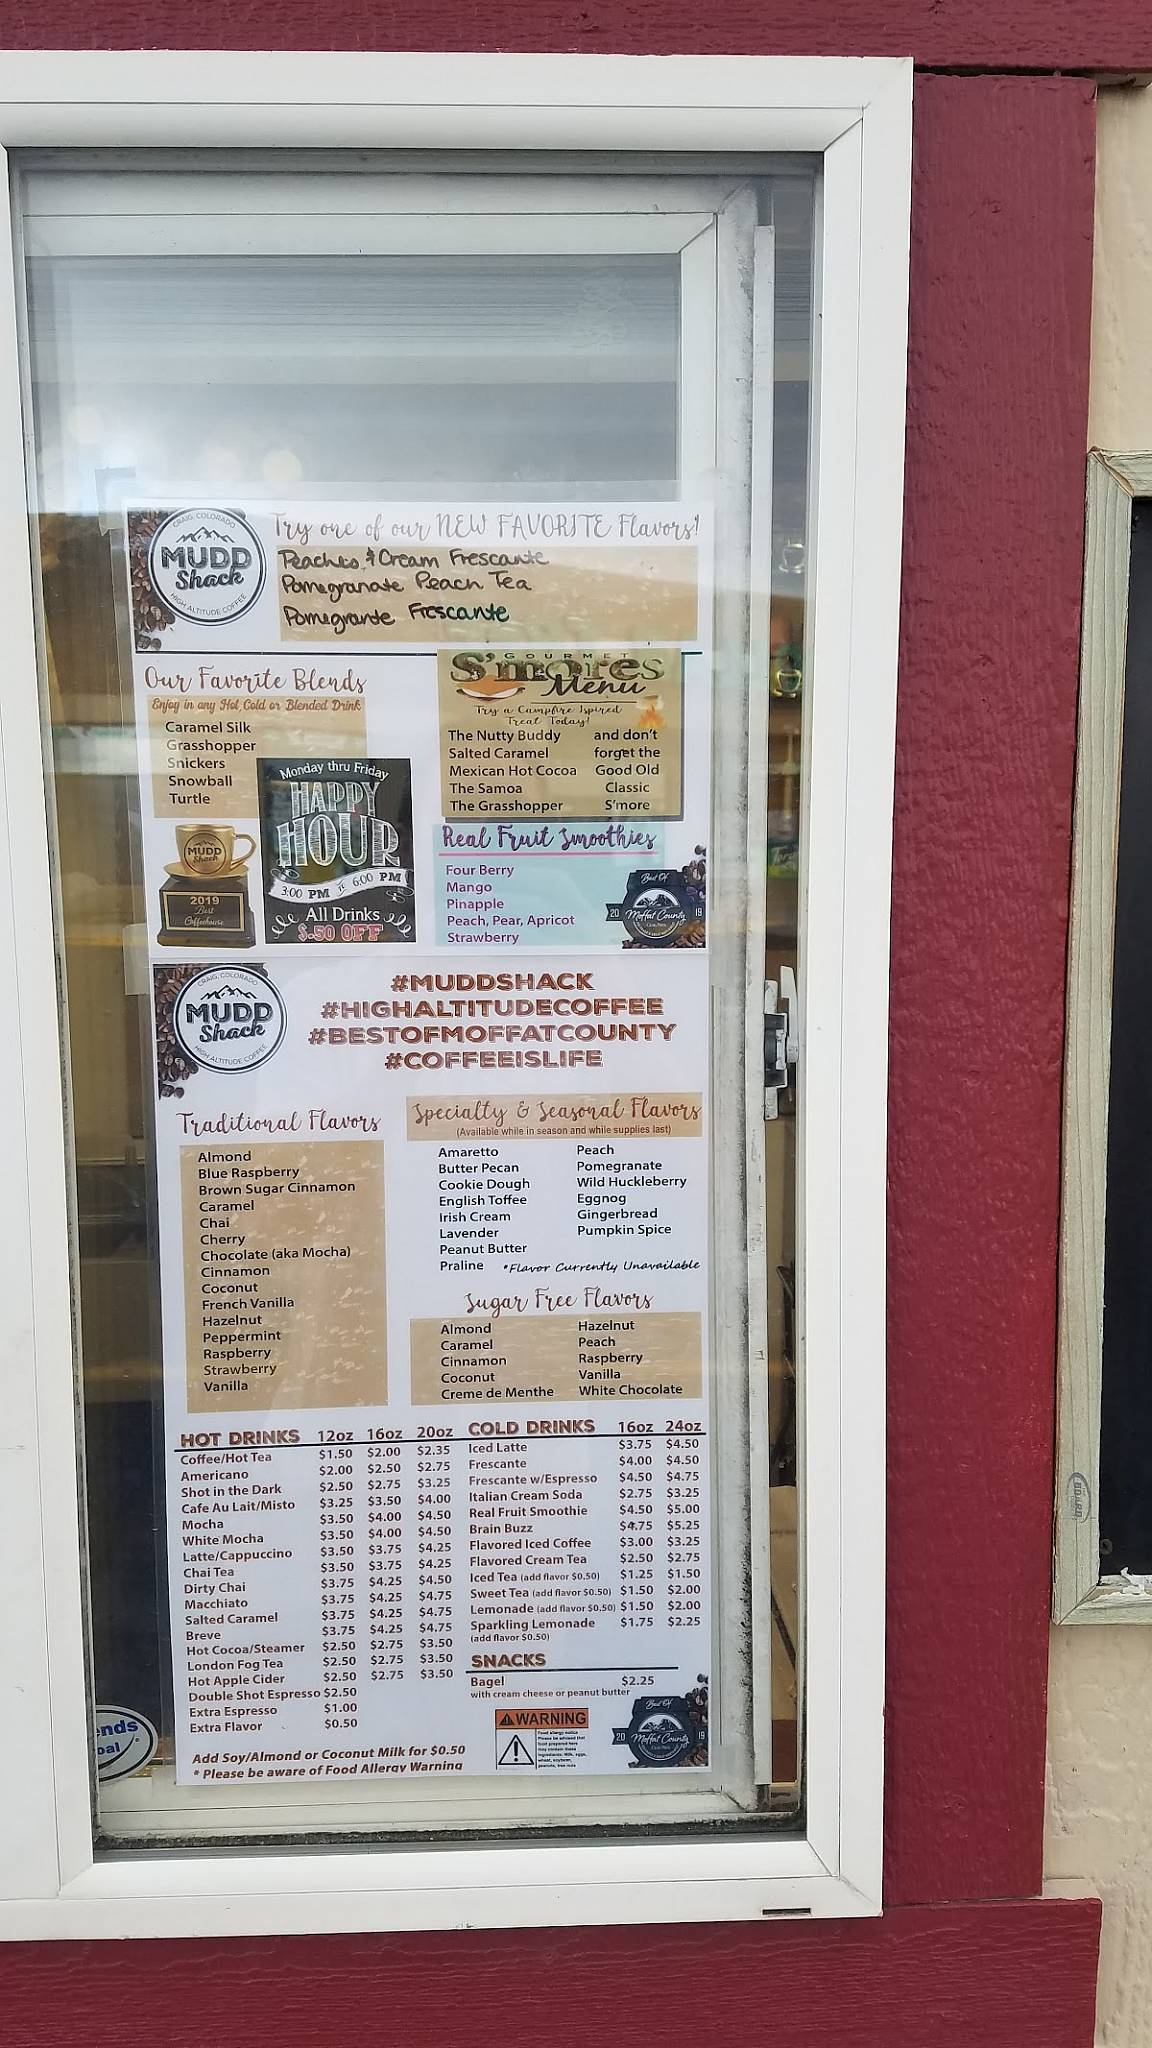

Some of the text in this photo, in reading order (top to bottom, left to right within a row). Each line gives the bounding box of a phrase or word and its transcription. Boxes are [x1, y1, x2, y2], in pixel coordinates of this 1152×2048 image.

[269, 512, 700, 545] Try one of our NEW FAVORITE Flavors!
[160, 546, 252, 570] MUDD
[379, 548, 439, 568] Cream
[449, 548, 550, 567] Frescante
[175, 567, 244, 591] Shack
[282, 570, 532, 603] Pomegranate Peach Tea
[170, 591, 248, 616] HIGH ALTITUDE COFFEE
[407, 602, 510, 623] Frescante
[504, 652, 628, 660] GOURMET
[450, 652, 664, 682] S'mores
[144, 665, 367, 694] Our Favorite Blends
[541, 674, 647, 697] Menu
[152, 698, 180, 713] Enjoy
[184, 699, 194, 711] in
[197, 701, 216, 713] any
[243, 698, 267, 712] Cold
[269, 702, 281, 712] or
[285, 699, 328, 712] Blended
[332, 699, 361, 712] Drink
[474, 705, 500, 716] Try
[517, 704, 576, 716] Campfire
[165, 720, 251, 734] Caramel Silk
[550, 716, 590, 728] Today!
[449, 729, 561, 744] The Nutty Buddy
[594, 728, 658, 741] and don't
[166, 739, 256, 754] Grasshopper
[449, 747, 549, 759] Salted Caramel
[594, 747, 660, 762] forget the
[167, 757, 226, 770] Snickers
[279, 760, 390, 781] Monday thru Friday
[169, 775, 233, 788] Snowball
[169, 793, 210, 805] Turtle
[289, 780, 381, 818] HAPPY
[276, 812, 401, 868] HOUR
[442, 823, 657, 852] Real Fruit Smoothies
[188, 847, 222, 856] MUDD
[446, 864, 514, 878] Four Berry
[280, 886, 303, 899] 3:00
[307, 888, 330, 900] PM
[352, 872, 375, 887] 6:00
[379, 872, 402, 882] PM
[446, 882, 493, 896] Mango
[190, 896, 220, 905] 2019
[447, 899, 504, 913] Pinapple
[305, 907, 380, 922] All Drinks
[610, 907, 703, 926] 20 Moffat County 19
[298, 924, 383, 942] $.50 OFF
[447, 932, 519, 945] Strawberry
[390, 973, 595, 993] #MUDDSHACK
[186, 1002, 273, 1024] MUDD
[320, 998, 665, 1020] #HIGHALTITUDECOFFEE
[199, 1020, 265, 1043] Shack
[308, 1023, 677, 1045] #BESTOFMOFFATCOUNTY
[384, 1050, 603, 1070] #COFFEEISLIFE
[412, 1096, 702, 1128] Specialty & Seasonal Flavors
[176, 1109, 381, 1136] Traditional Flavors
[198, 1151, 251, 1163] Almond
[577, 1175, 687, 1188] Wild Huckleberry
[439, 1194, 527, 1209] English Toffee
[577, 1224, 671, 1238] Pumpkin Spice
[201, 1246, 351, 1262] Chocolate (aka Mocha)
[464, 1286, 654, 1318] Sugar Free Flavors
[578, 1320, 635, 1331] Hazelnut
[203, 1331, 281, 1345] Peppermint
[441, 1386, 554, 1400] Creme de Menthe
[579, 1384, 683, 1397] White Chocolate
[468, 1418, 702, 1436] COLD DRINKS 16oz 24oz
[180, 1426, 453, 1448] HOT DRINKS 12oz 16oz 20oz
[469, 1454, 700, 1470] Frescante $4.00 $4.50
[181, 1461, 451, 1482] Americano $2.00 $2.50 $2.75
[471, 1616, 701, 1632] Sparkling Lemonade $1.75 $2.25
[471, 1652, 547, 1668] SNACKS
[471, 1675, 655, 1689] Bagel $2.25
[516, 1712, 586, 1725] WARNING
[192, 1744, 466, 1765] Add Soy/Almond or Coconut Milk for $0.50
